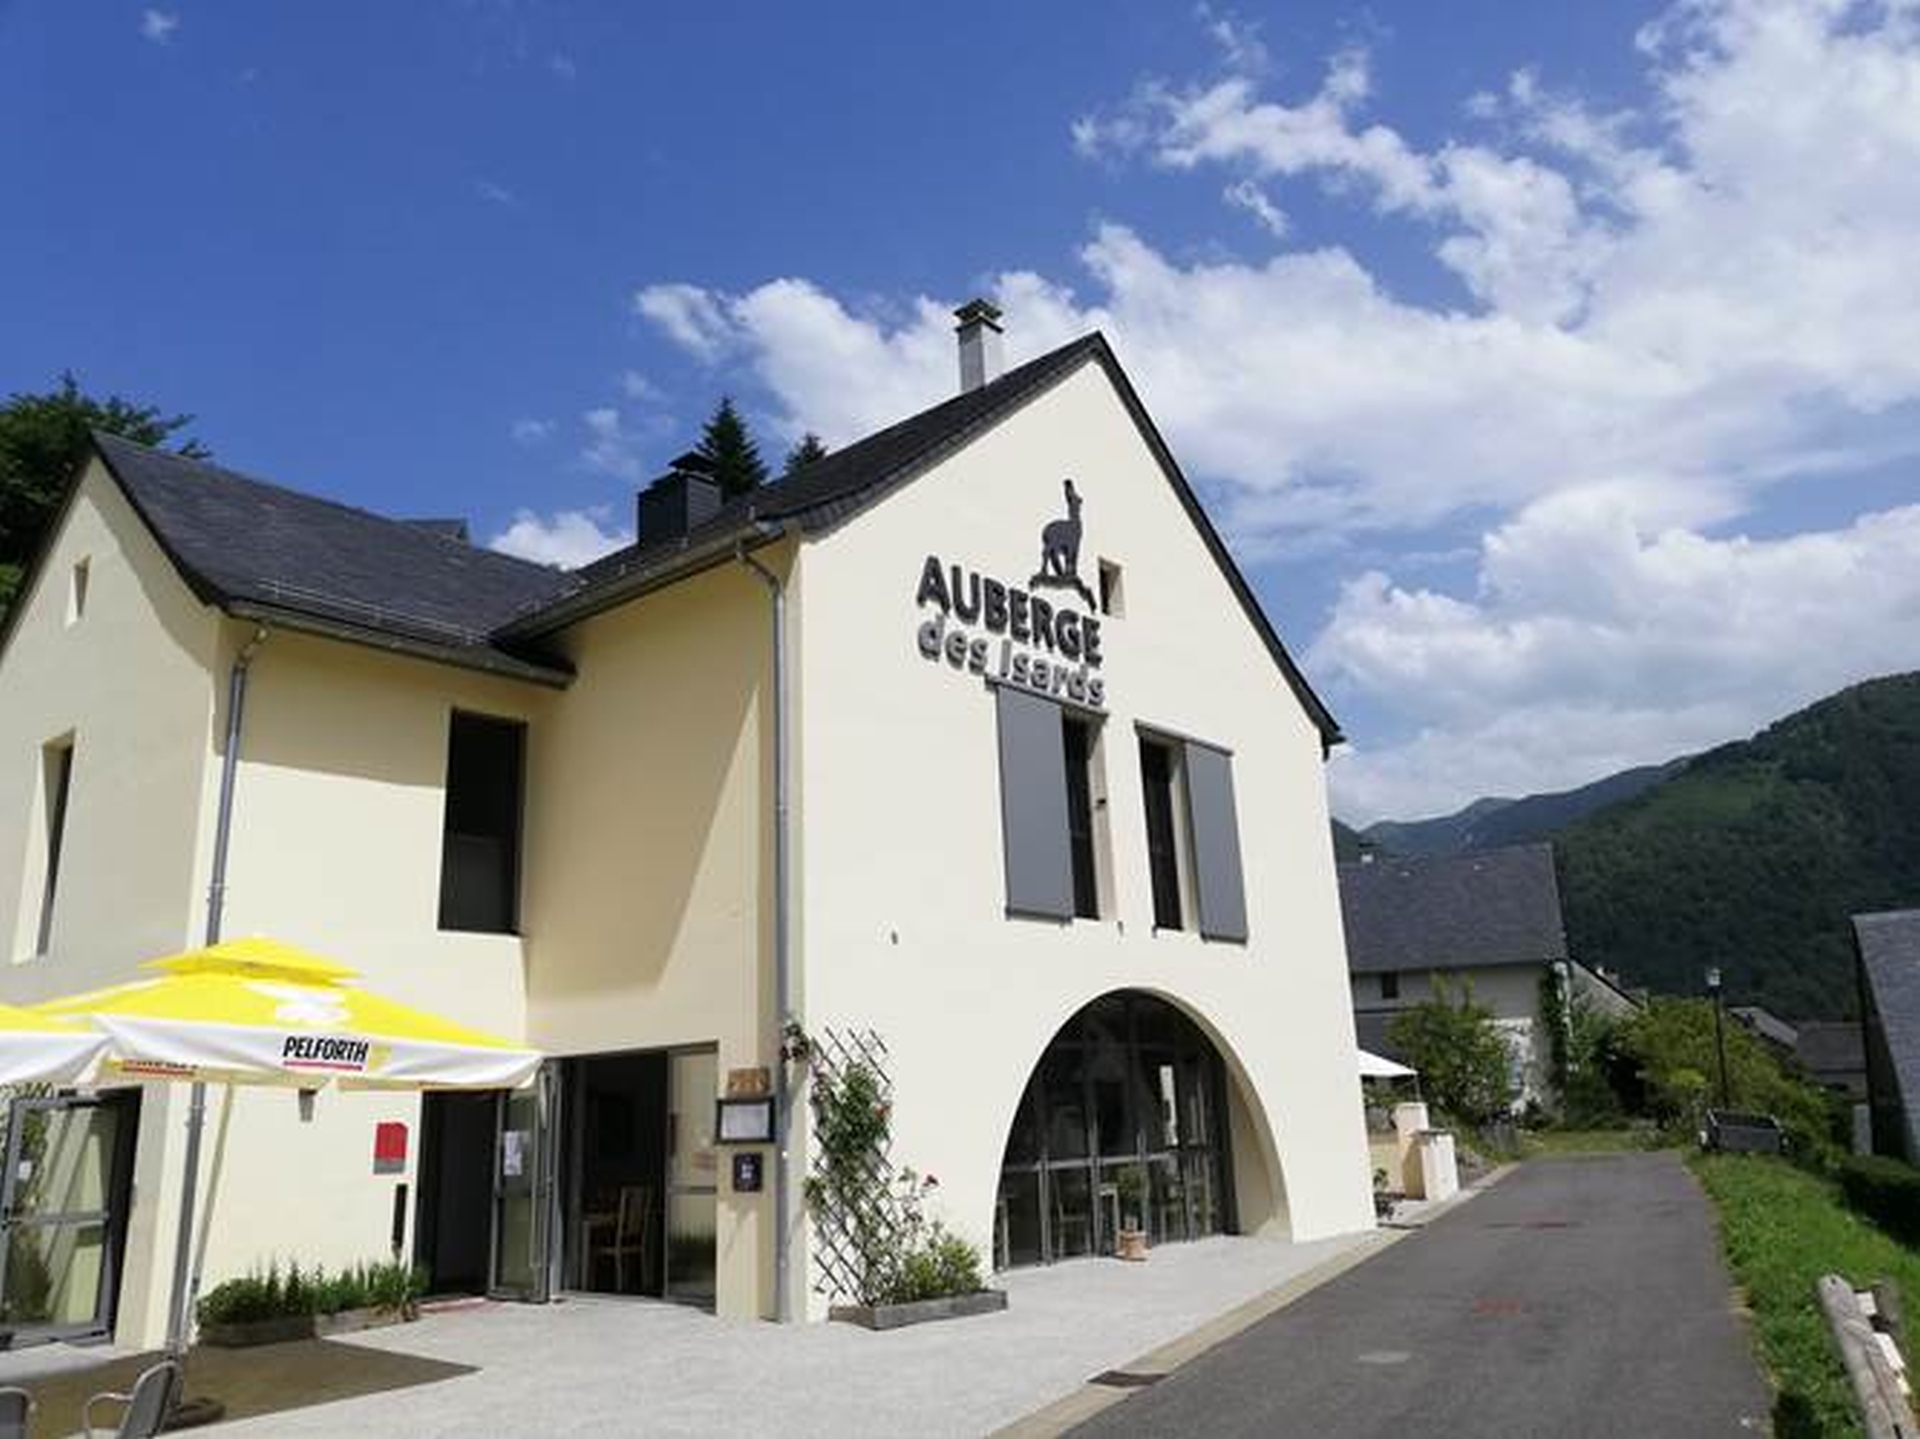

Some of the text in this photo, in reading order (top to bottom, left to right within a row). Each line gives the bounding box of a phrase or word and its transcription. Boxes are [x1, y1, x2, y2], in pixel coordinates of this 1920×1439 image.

[917, 555, 1102, 668] AUBERGE
[917, 613, 1104, 706] des Isards
[283, 1035, 369, 1062] PELFORTH
